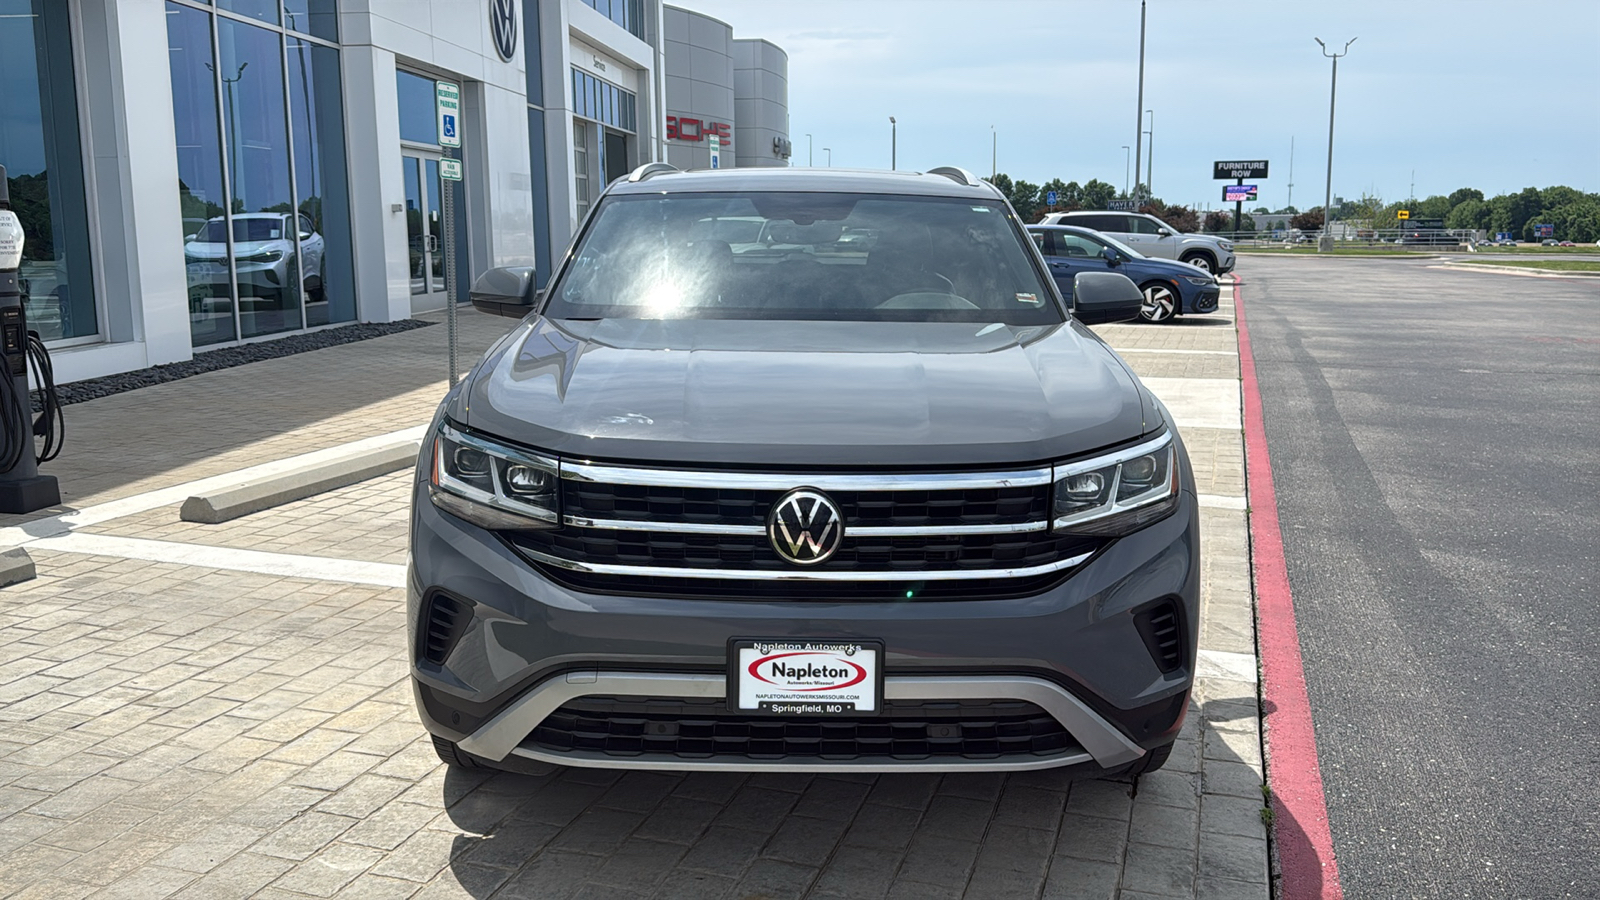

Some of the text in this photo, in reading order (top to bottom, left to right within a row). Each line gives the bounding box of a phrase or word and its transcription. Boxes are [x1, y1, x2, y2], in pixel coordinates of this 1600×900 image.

[593, 54, 606, 72] Service
[438, 89, 459, 99] RESERVED
[440, 99, 457, 109] PARKING
[1218, 162, 1265, 170] FURNITURE
[1231, 170, 1251, 178] ROW
[753, 642, 862, 651] Napleton Autowerks
[772, 662, 849, 680] Napleton
[771, 704, 842, 714] Springfield, MO
